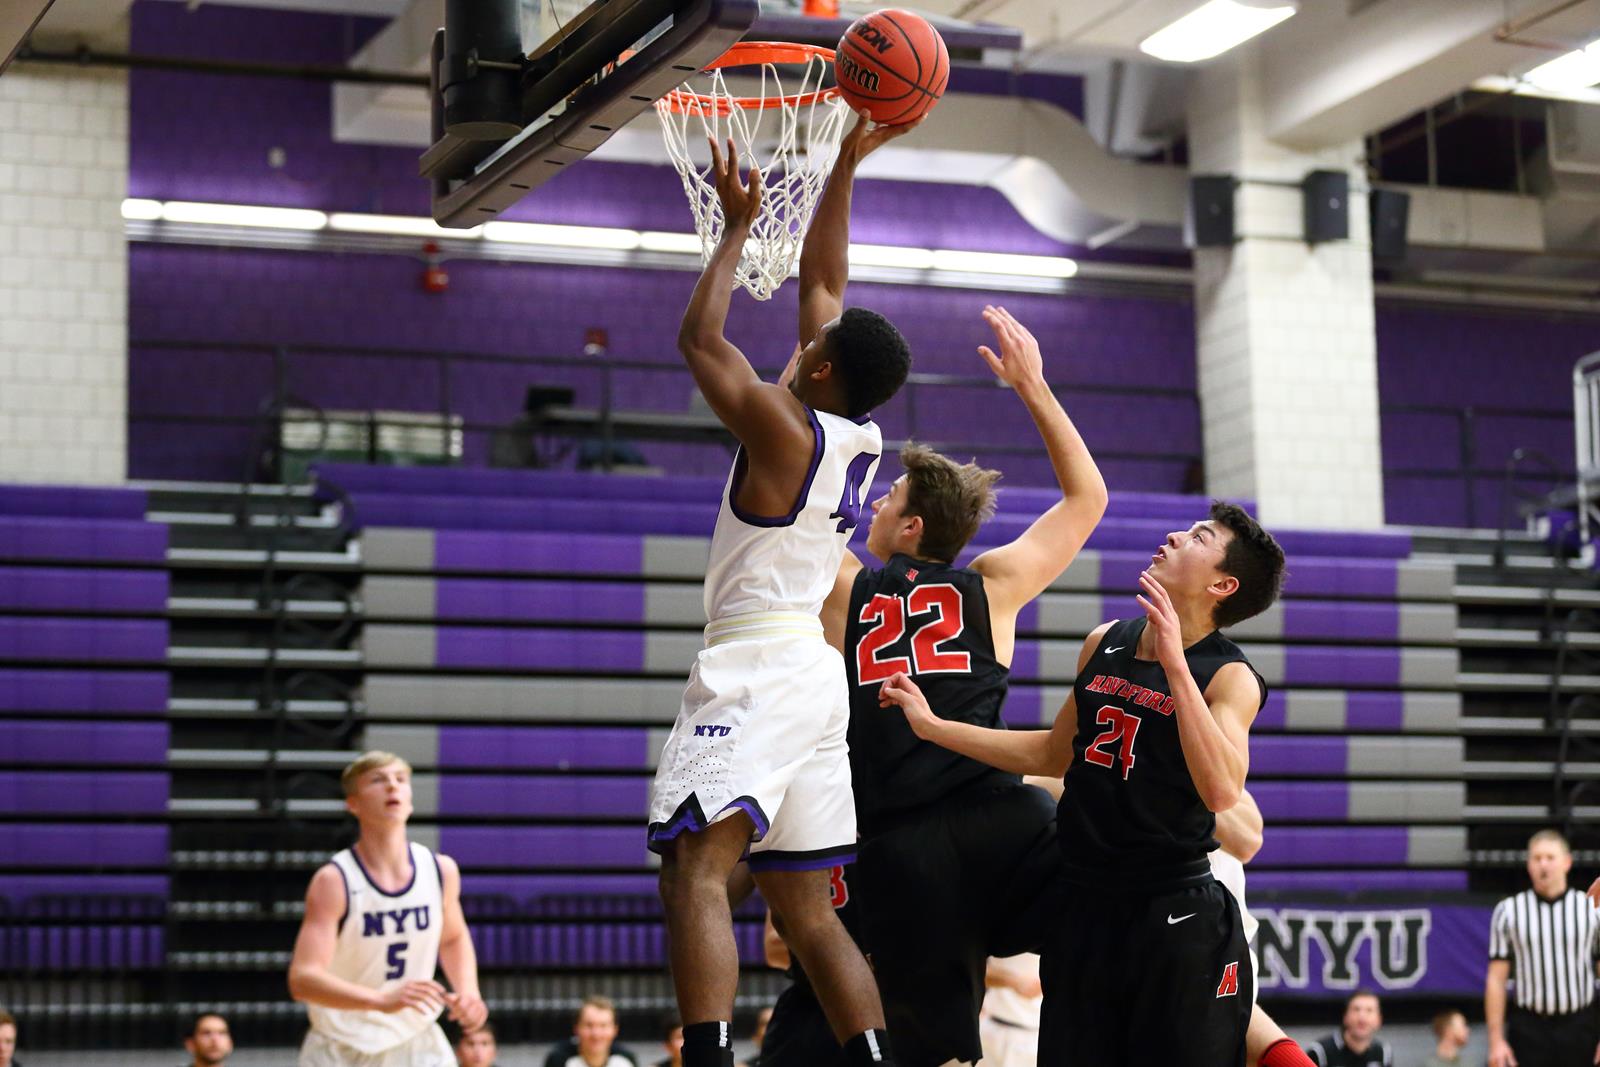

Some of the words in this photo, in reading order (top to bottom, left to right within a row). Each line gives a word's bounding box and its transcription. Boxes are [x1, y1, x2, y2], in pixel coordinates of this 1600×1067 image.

[851, 22, 894, 54] NCA
[836, 49, 880, 93] Wilso
[829, 451, 880, 534] 4
[856, 583, 972, 686] 22
[1085, 674, 1176, 716] HAVFORD
[693, 725, 732, 737] NYU
[1085, 705, 1142, 780] 24
[362, 905, 429, 936] NYU
[385, 941, 408, 980] 5
[1250, 908, 1431, 989] NYU
[1216, 961, 1239, 998] H
